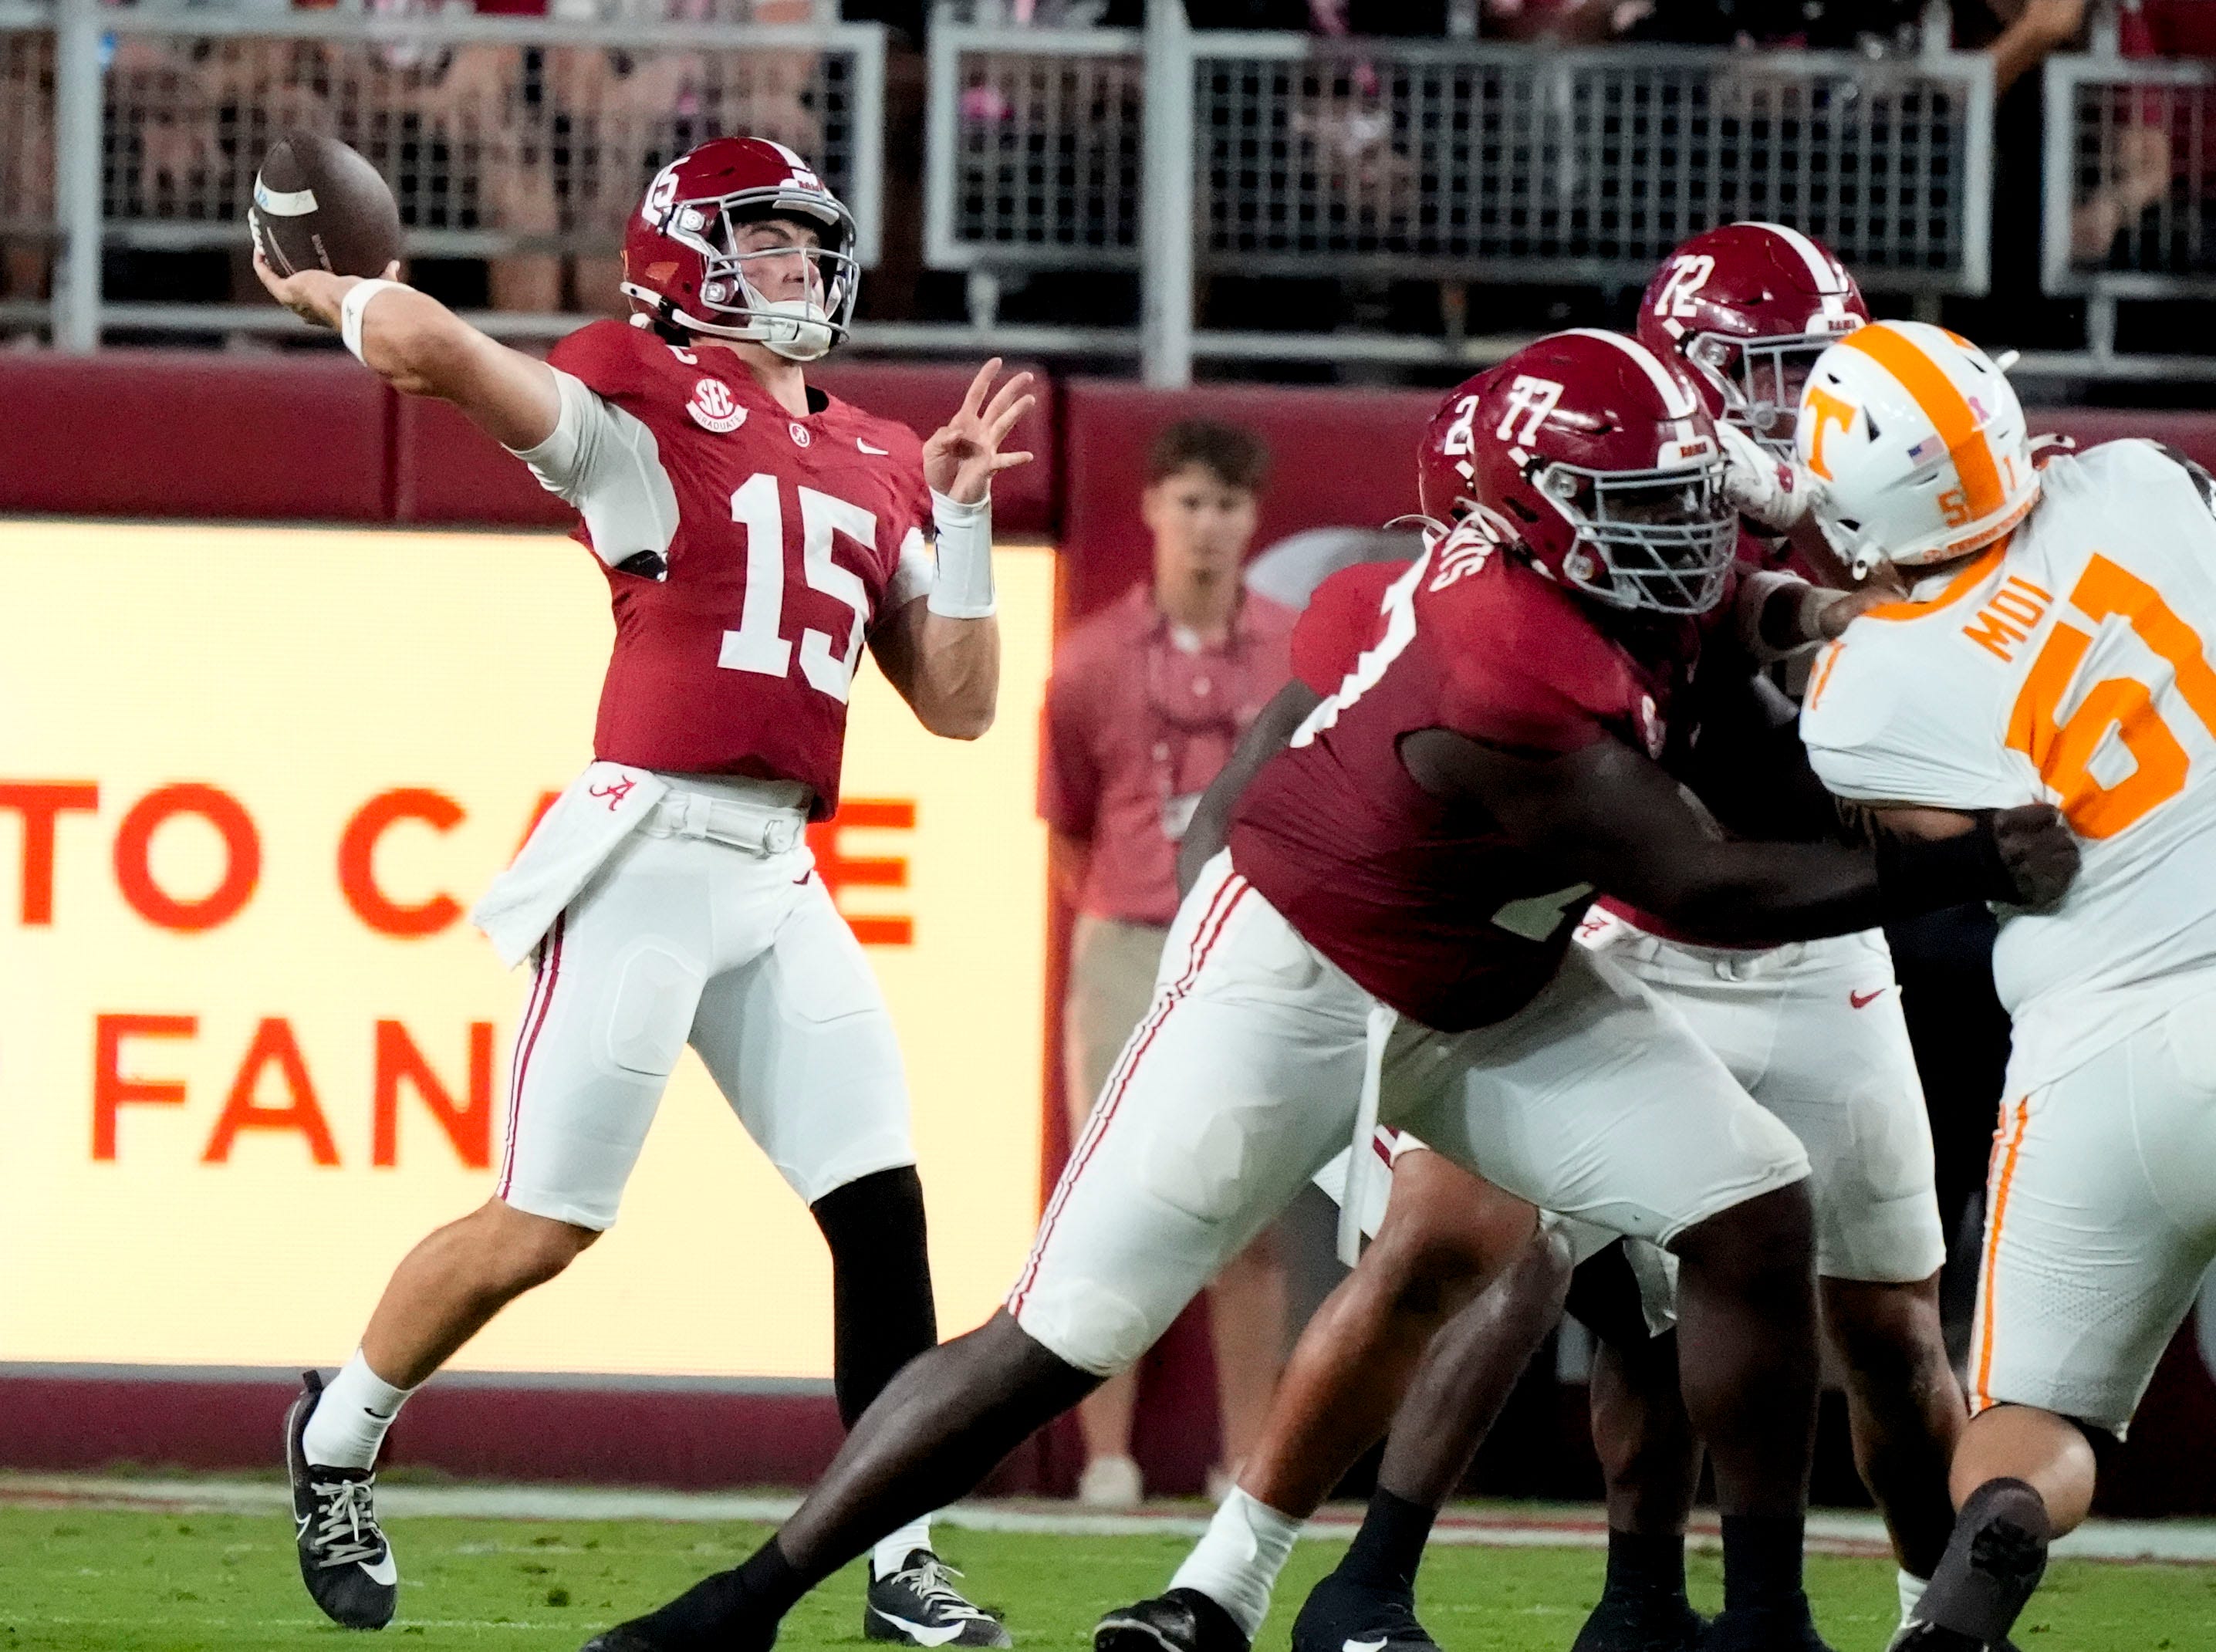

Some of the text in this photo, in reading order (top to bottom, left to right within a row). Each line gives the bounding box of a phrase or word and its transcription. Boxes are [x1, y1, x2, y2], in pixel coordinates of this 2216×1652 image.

[1654, 255, 1715, 317] 72
[695, 412, 741, 430] GRADUATE
[696, 378, 734, 417] SEC
[1444, 395, 1482, 455] 2
[1496, 374, 1565, 448] 77
[718, 473, 877, 705] 15
[1962, 575, 2055, 663] MOI
[0, 781, 916, 946] TO CE
[92, 1013, 495, 1169] FAN
